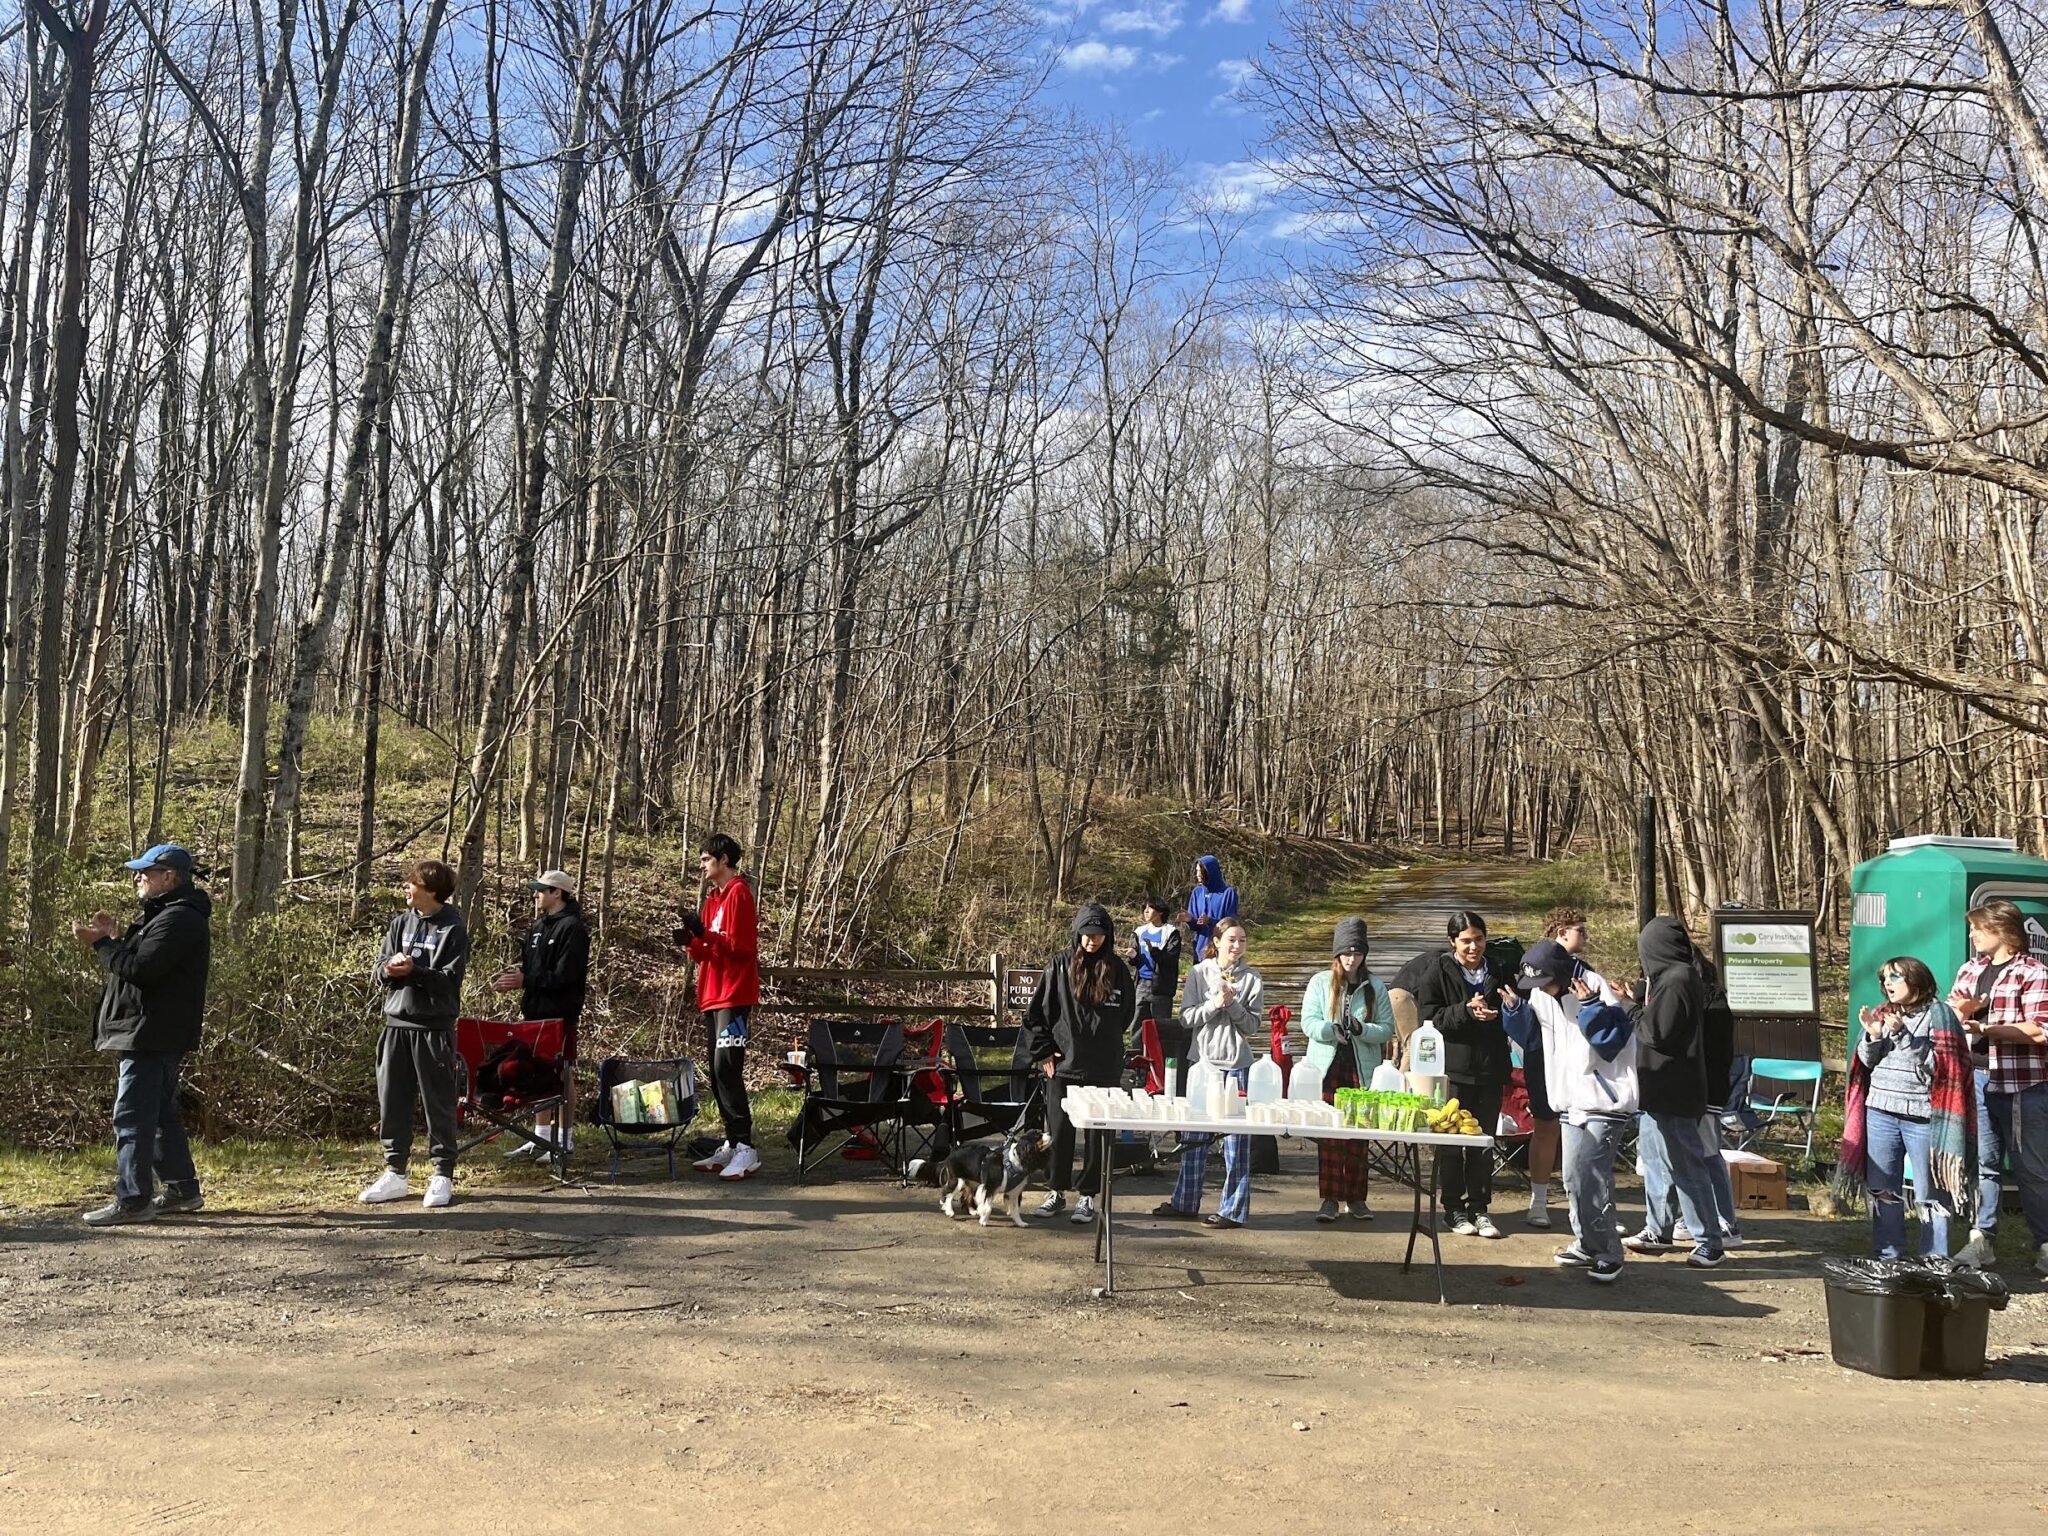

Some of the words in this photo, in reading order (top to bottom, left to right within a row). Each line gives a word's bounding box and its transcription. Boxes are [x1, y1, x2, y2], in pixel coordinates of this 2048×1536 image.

[1019, 976, 1034, 985] NO
[1009, 986, 1037, 995] PUBLI
[1009, 996, 1033, 1005] ACCE
[716, 1035, 747, 1048] adid
